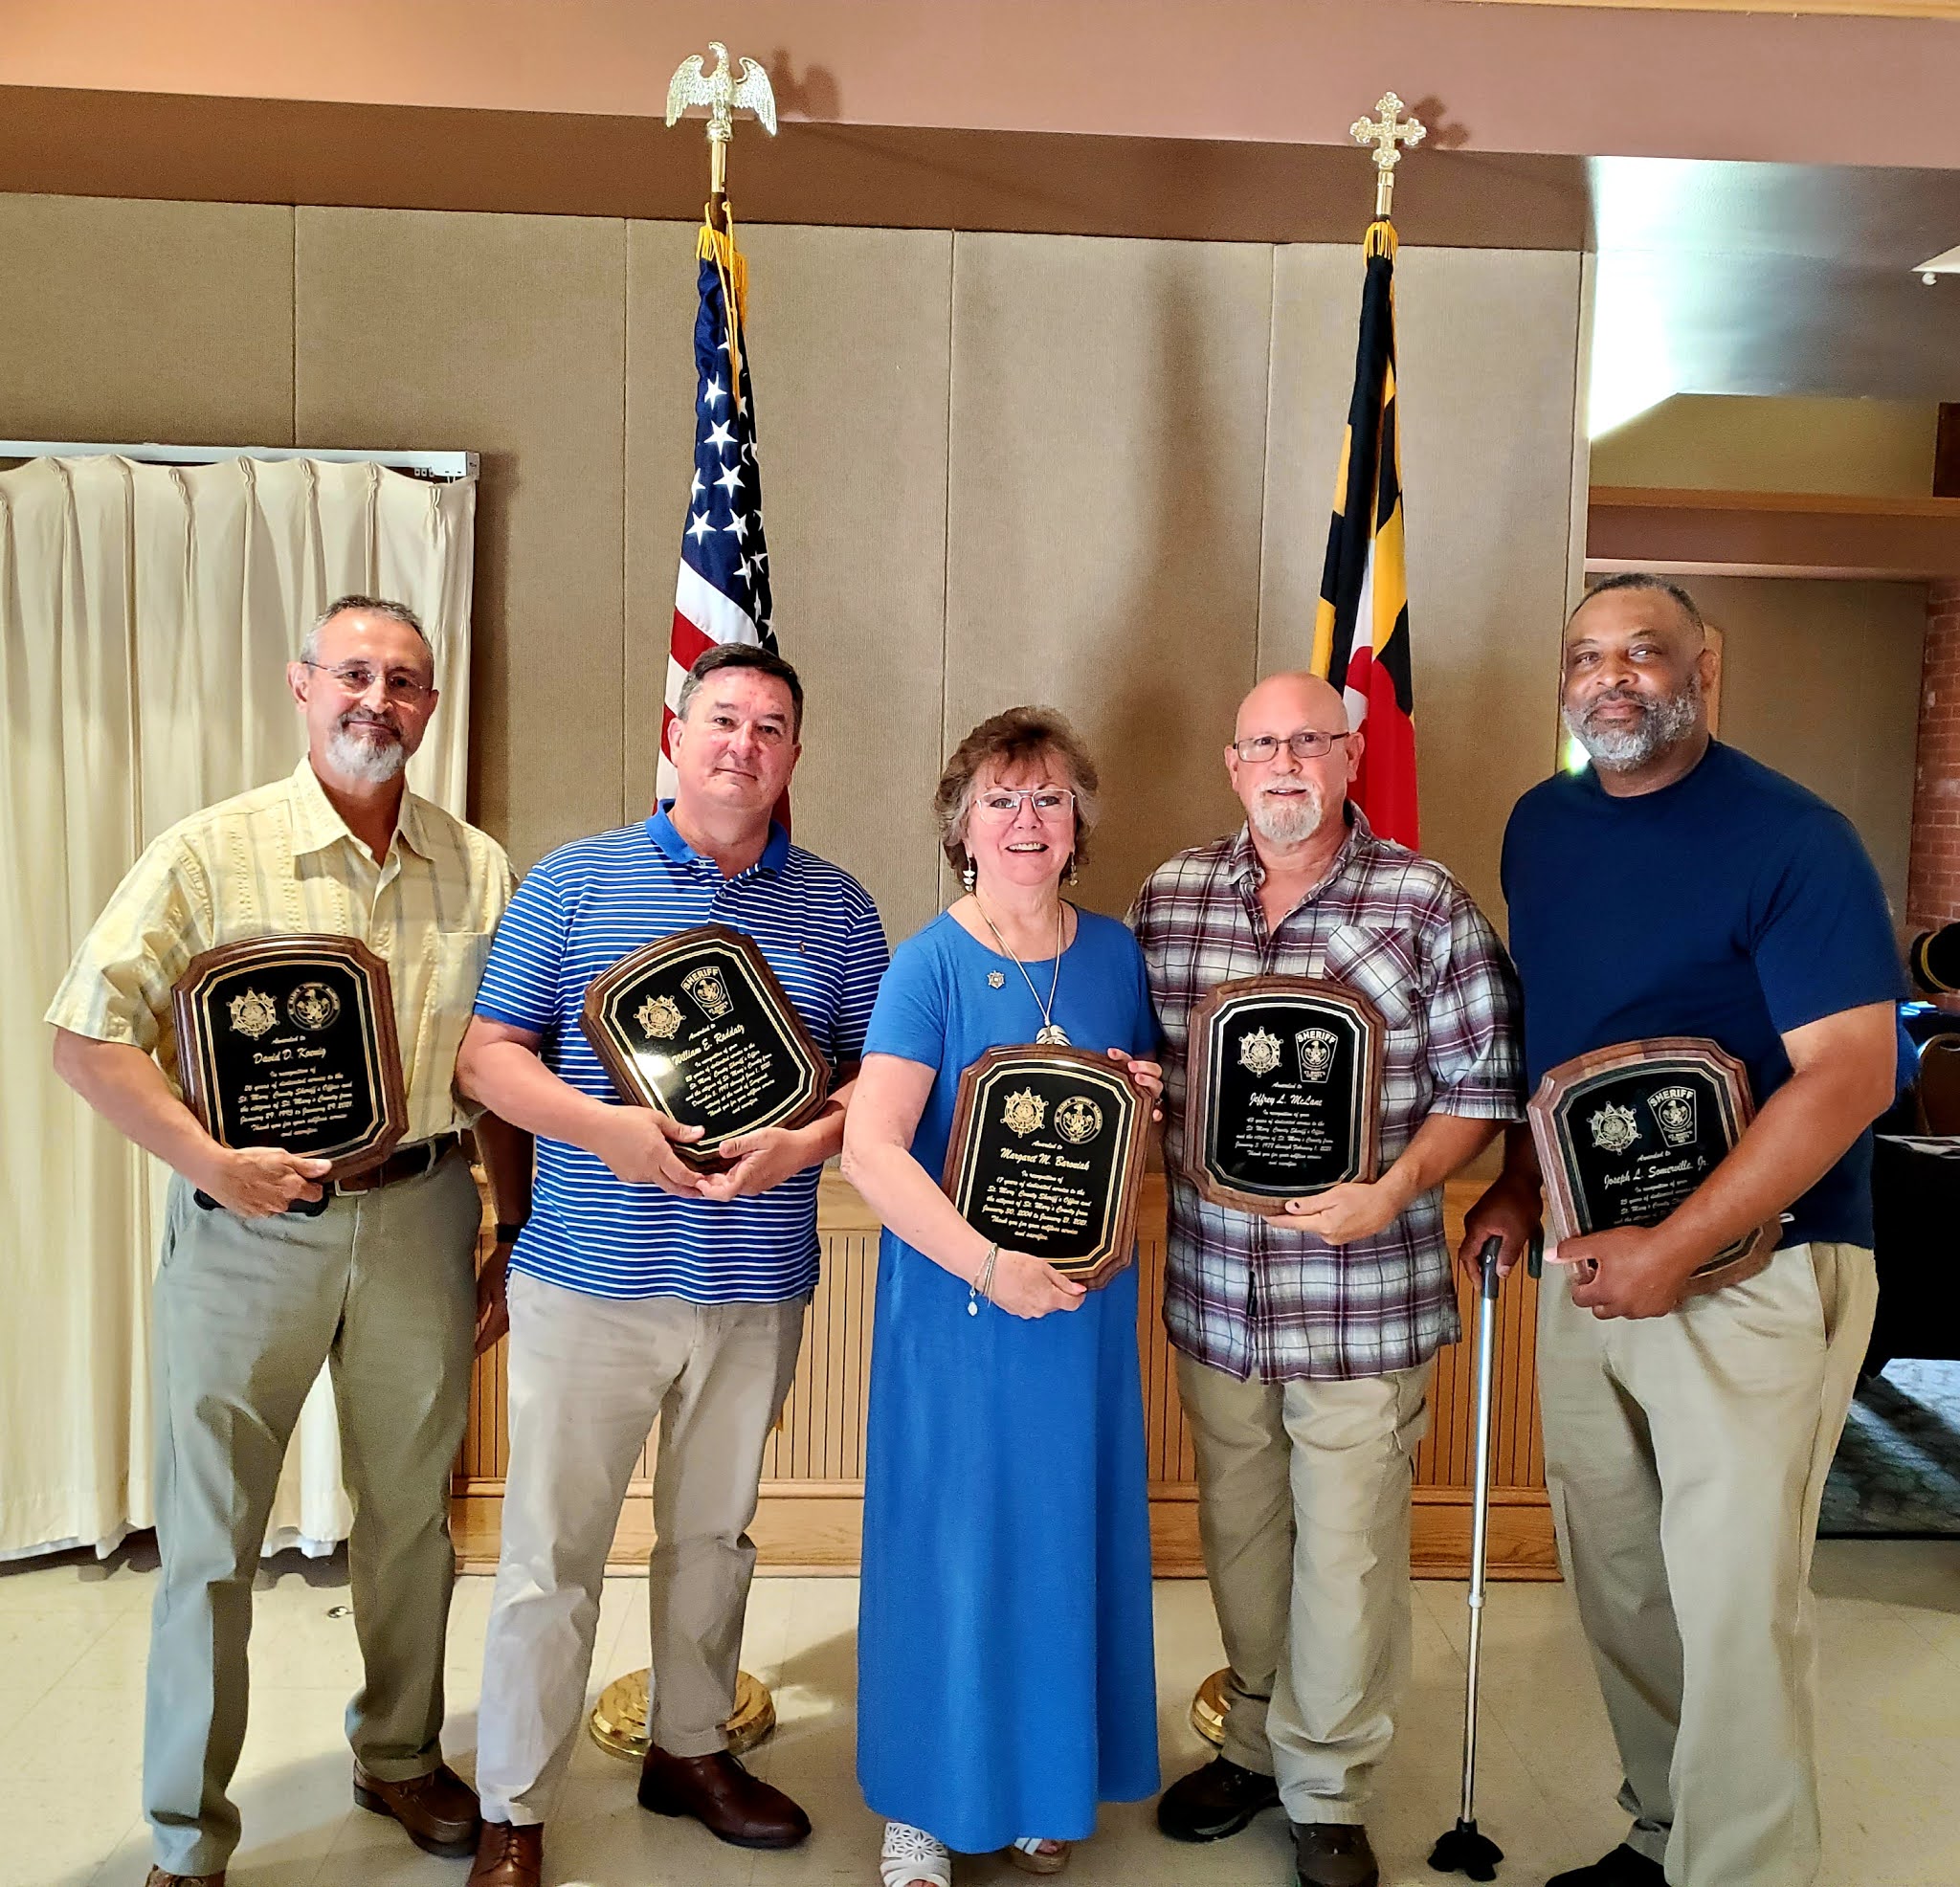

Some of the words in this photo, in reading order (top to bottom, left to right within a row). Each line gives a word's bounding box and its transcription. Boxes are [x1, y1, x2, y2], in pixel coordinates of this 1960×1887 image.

[683, 968, 718, 989] SHERIFF
[1298, 1031, 1336, 1043] SHERIFF
[253, 1052, 280, 1064] David
[671, 1048, 702, 1065] William
[1249, 1092, 1275, 1106] Jeffrey
[1277, 1094, 1286, 1103] L.
[1290, 1095, 1323, 1106] McLane
[1650, 1089, 1693, 1106] SHERIFF
[1000, 1147, 1038, 1164] Margaret
[1038, 1153, 1051, 1165] M.
[1605, 1170, 1630, 1189] Joseph
[1633, 1168, 1644, 1180] L.
